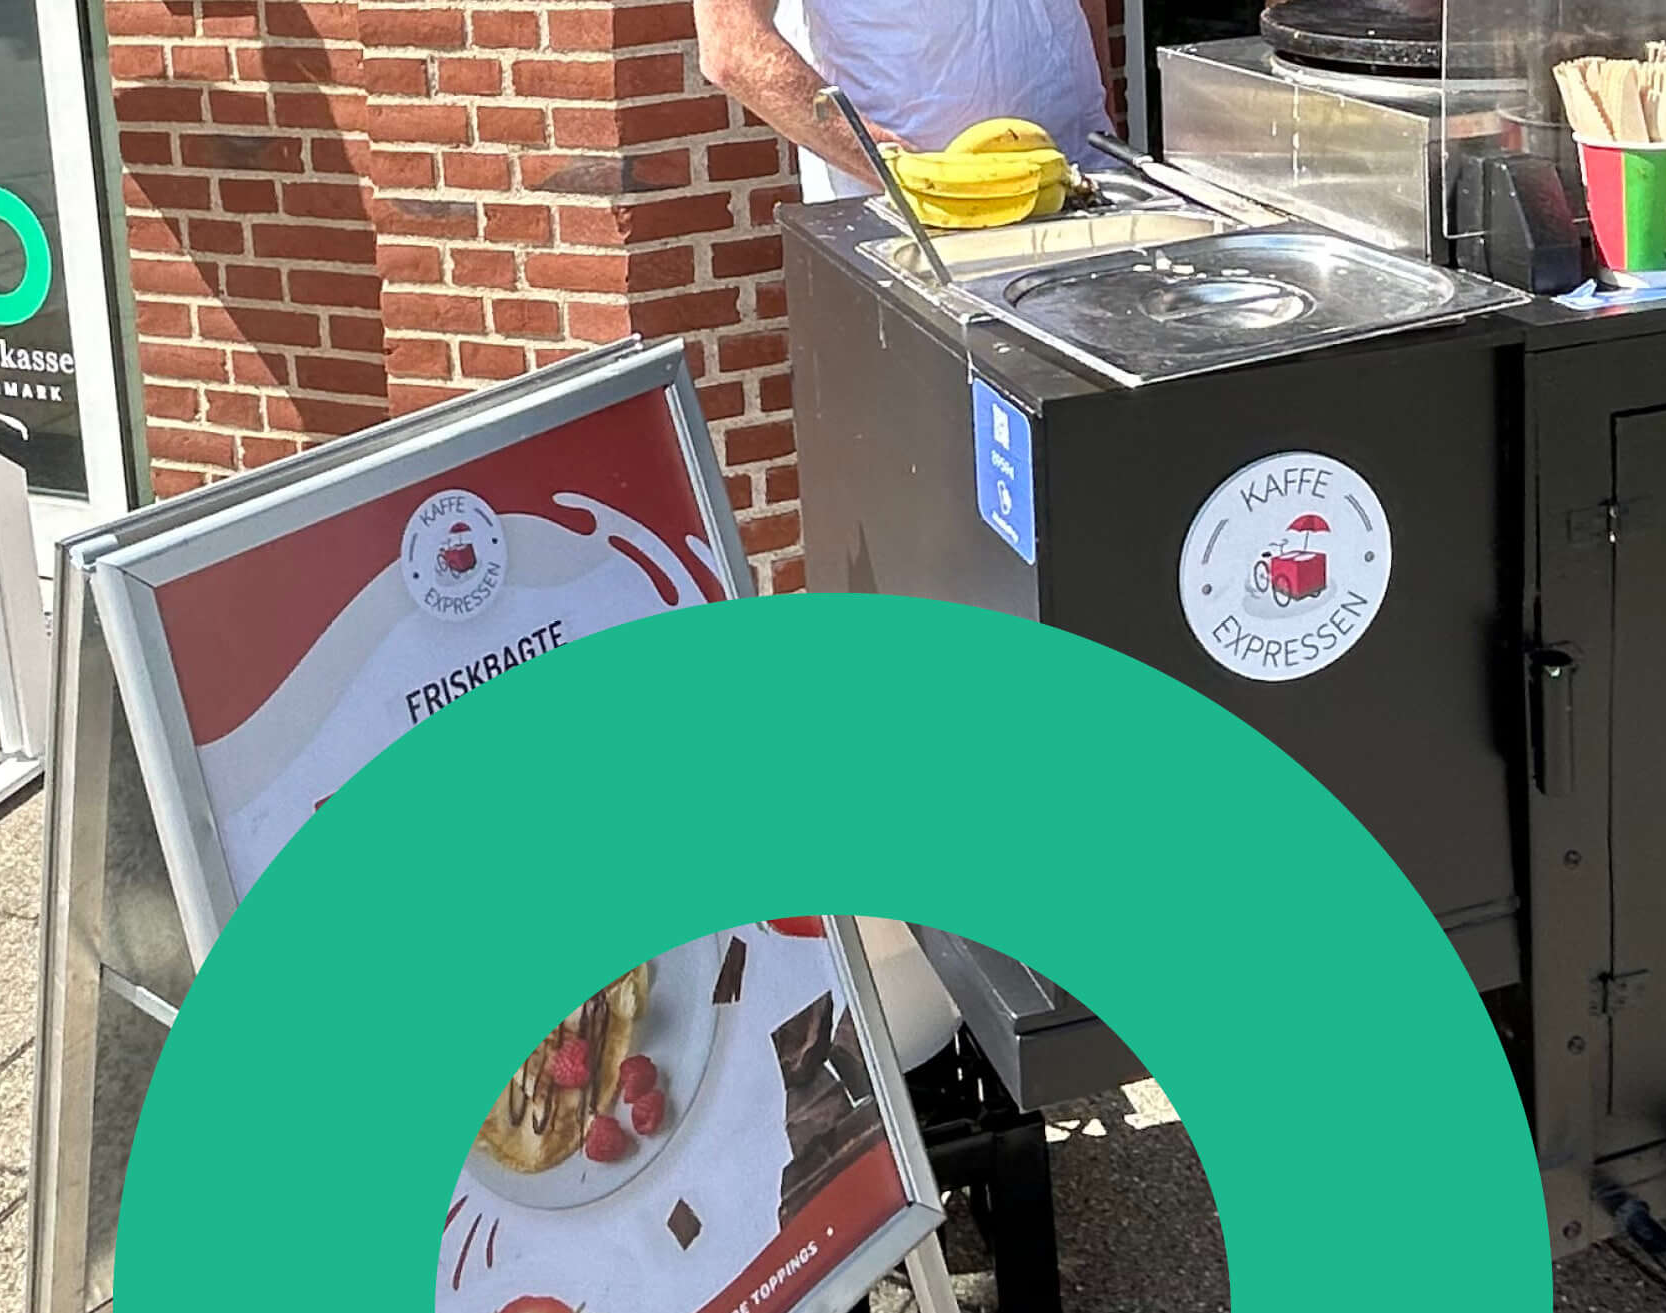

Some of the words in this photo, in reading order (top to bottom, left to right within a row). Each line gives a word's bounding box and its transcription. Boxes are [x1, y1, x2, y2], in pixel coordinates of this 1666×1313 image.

[419, 495, 466, 527] KAFFE
[1240, 467, 1333, 513] KAFFE
[424, 560, 502, 615] EXPRESSEN
[1211, 590, 1369, 668] EXPRESSEN
[405, 620, 568, 725] FRISKBAGTE
[750, 1240, 819, 1306] TOPPINGS
